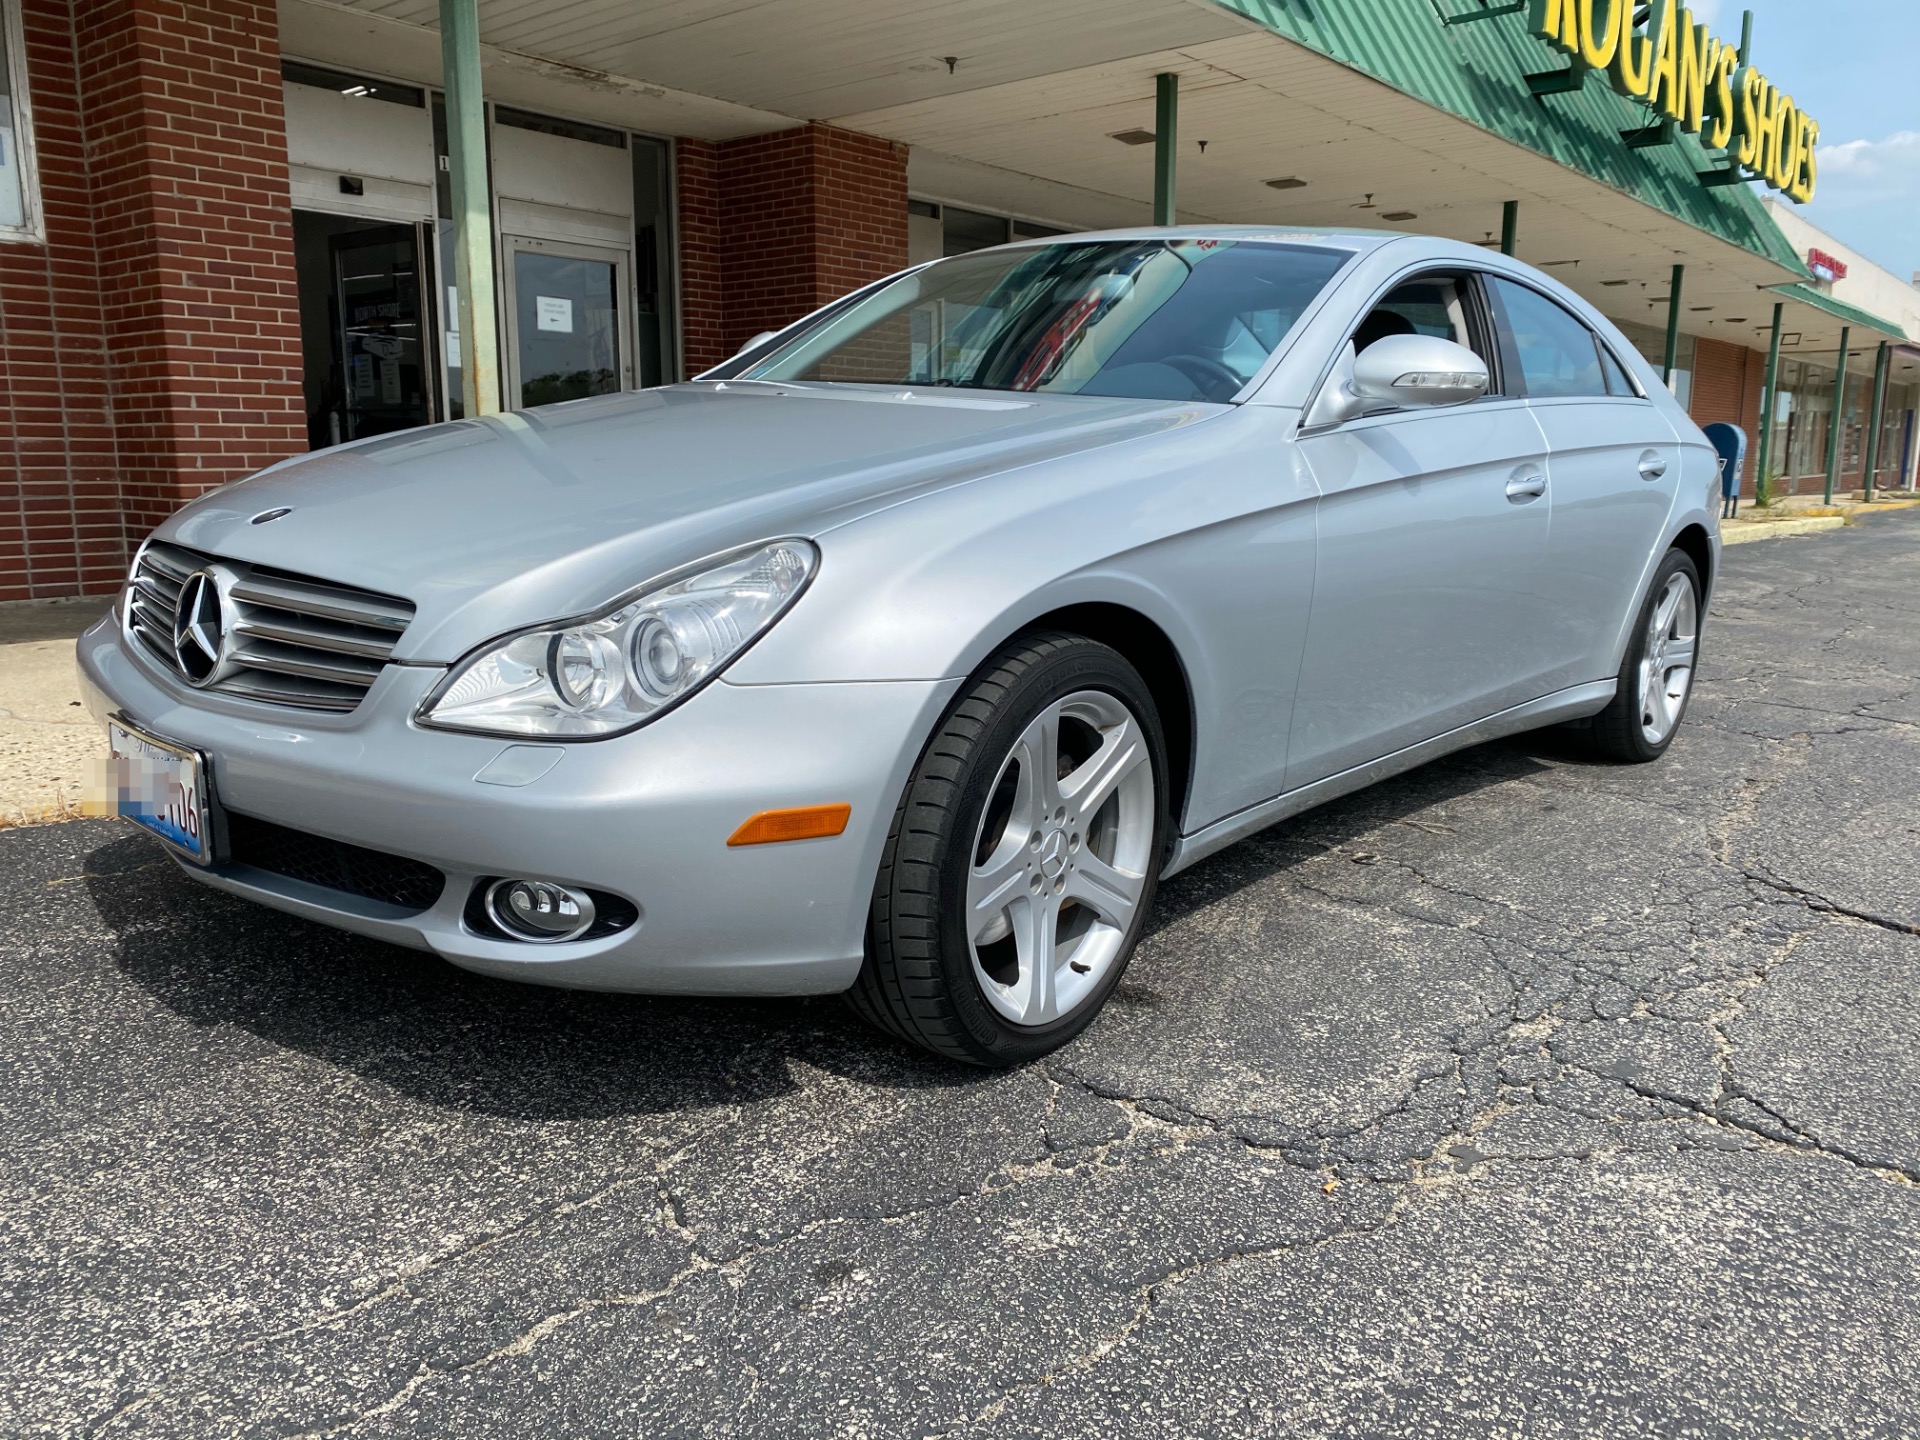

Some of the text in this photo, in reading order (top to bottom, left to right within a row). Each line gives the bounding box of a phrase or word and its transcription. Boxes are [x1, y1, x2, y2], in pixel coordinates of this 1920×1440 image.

[1540, 0, 1821, 205] OGAN'S SHOES
[354, 305, 377, 323] NORTH
[378, 302, 401, 319] SHORE
